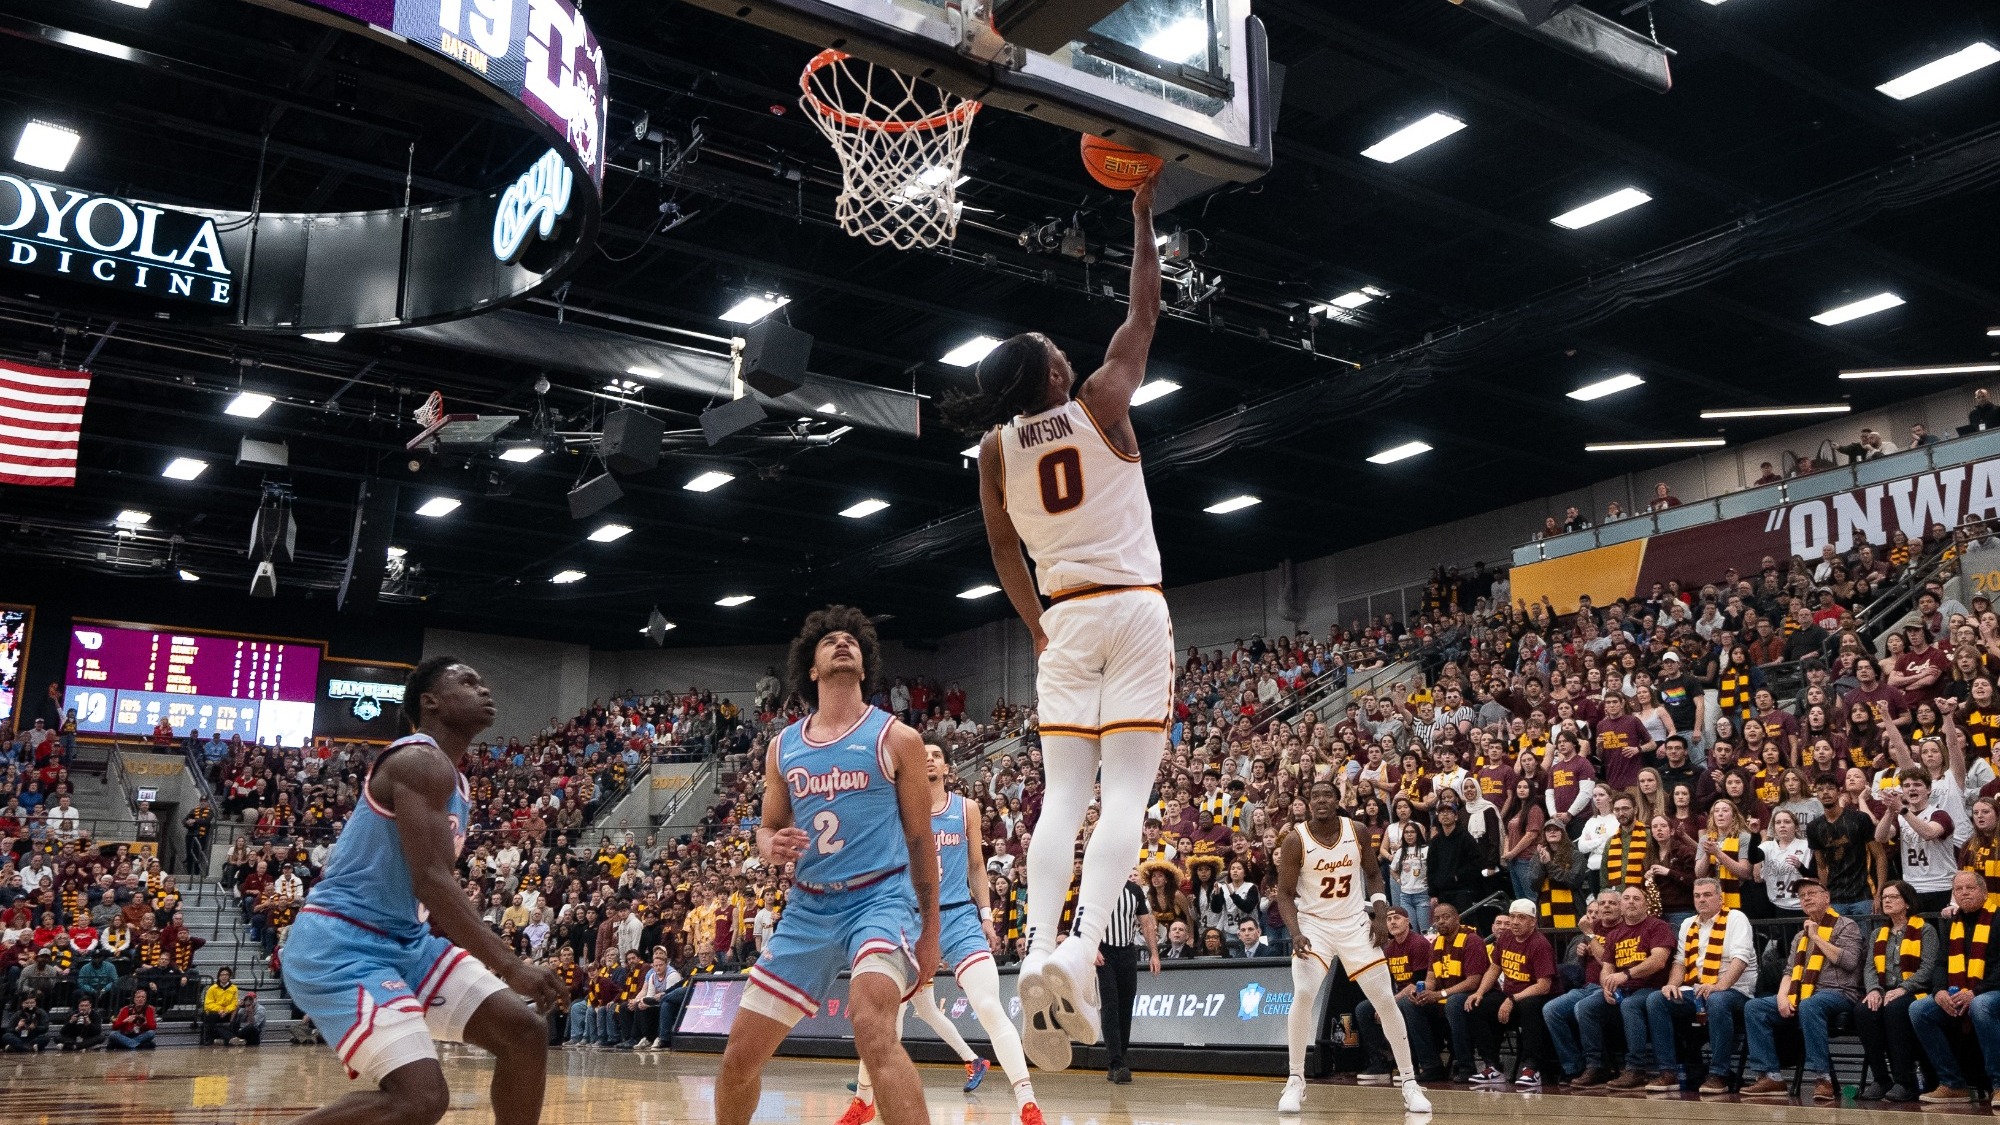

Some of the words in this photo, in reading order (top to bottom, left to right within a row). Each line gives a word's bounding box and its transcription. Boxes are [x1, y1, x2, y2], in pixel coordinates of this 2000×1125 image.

[441, 32, 488, 74] DAYTON
[1104, 158, 1149, 175] ELITE
[9, 241, 230, 304] DICINE
[1018, 413, 1073, 449] WATSON
[1038, 445, 1084, 516] 0
[74, 692, 107, 723] 19
[787, 765, 870, 801] Dayton
[812, 810, 845, 856] 2
[934, 828, 961, 851] yton
[1313, 854, 1354, 873] Loyola
[1907, 848, 1930, 867] 24
[1319, 874, 1353, 899] 23
[1176, 993, 1226, 1018] 12-17
[1262, 1004, 1290, 1016] CENTE
